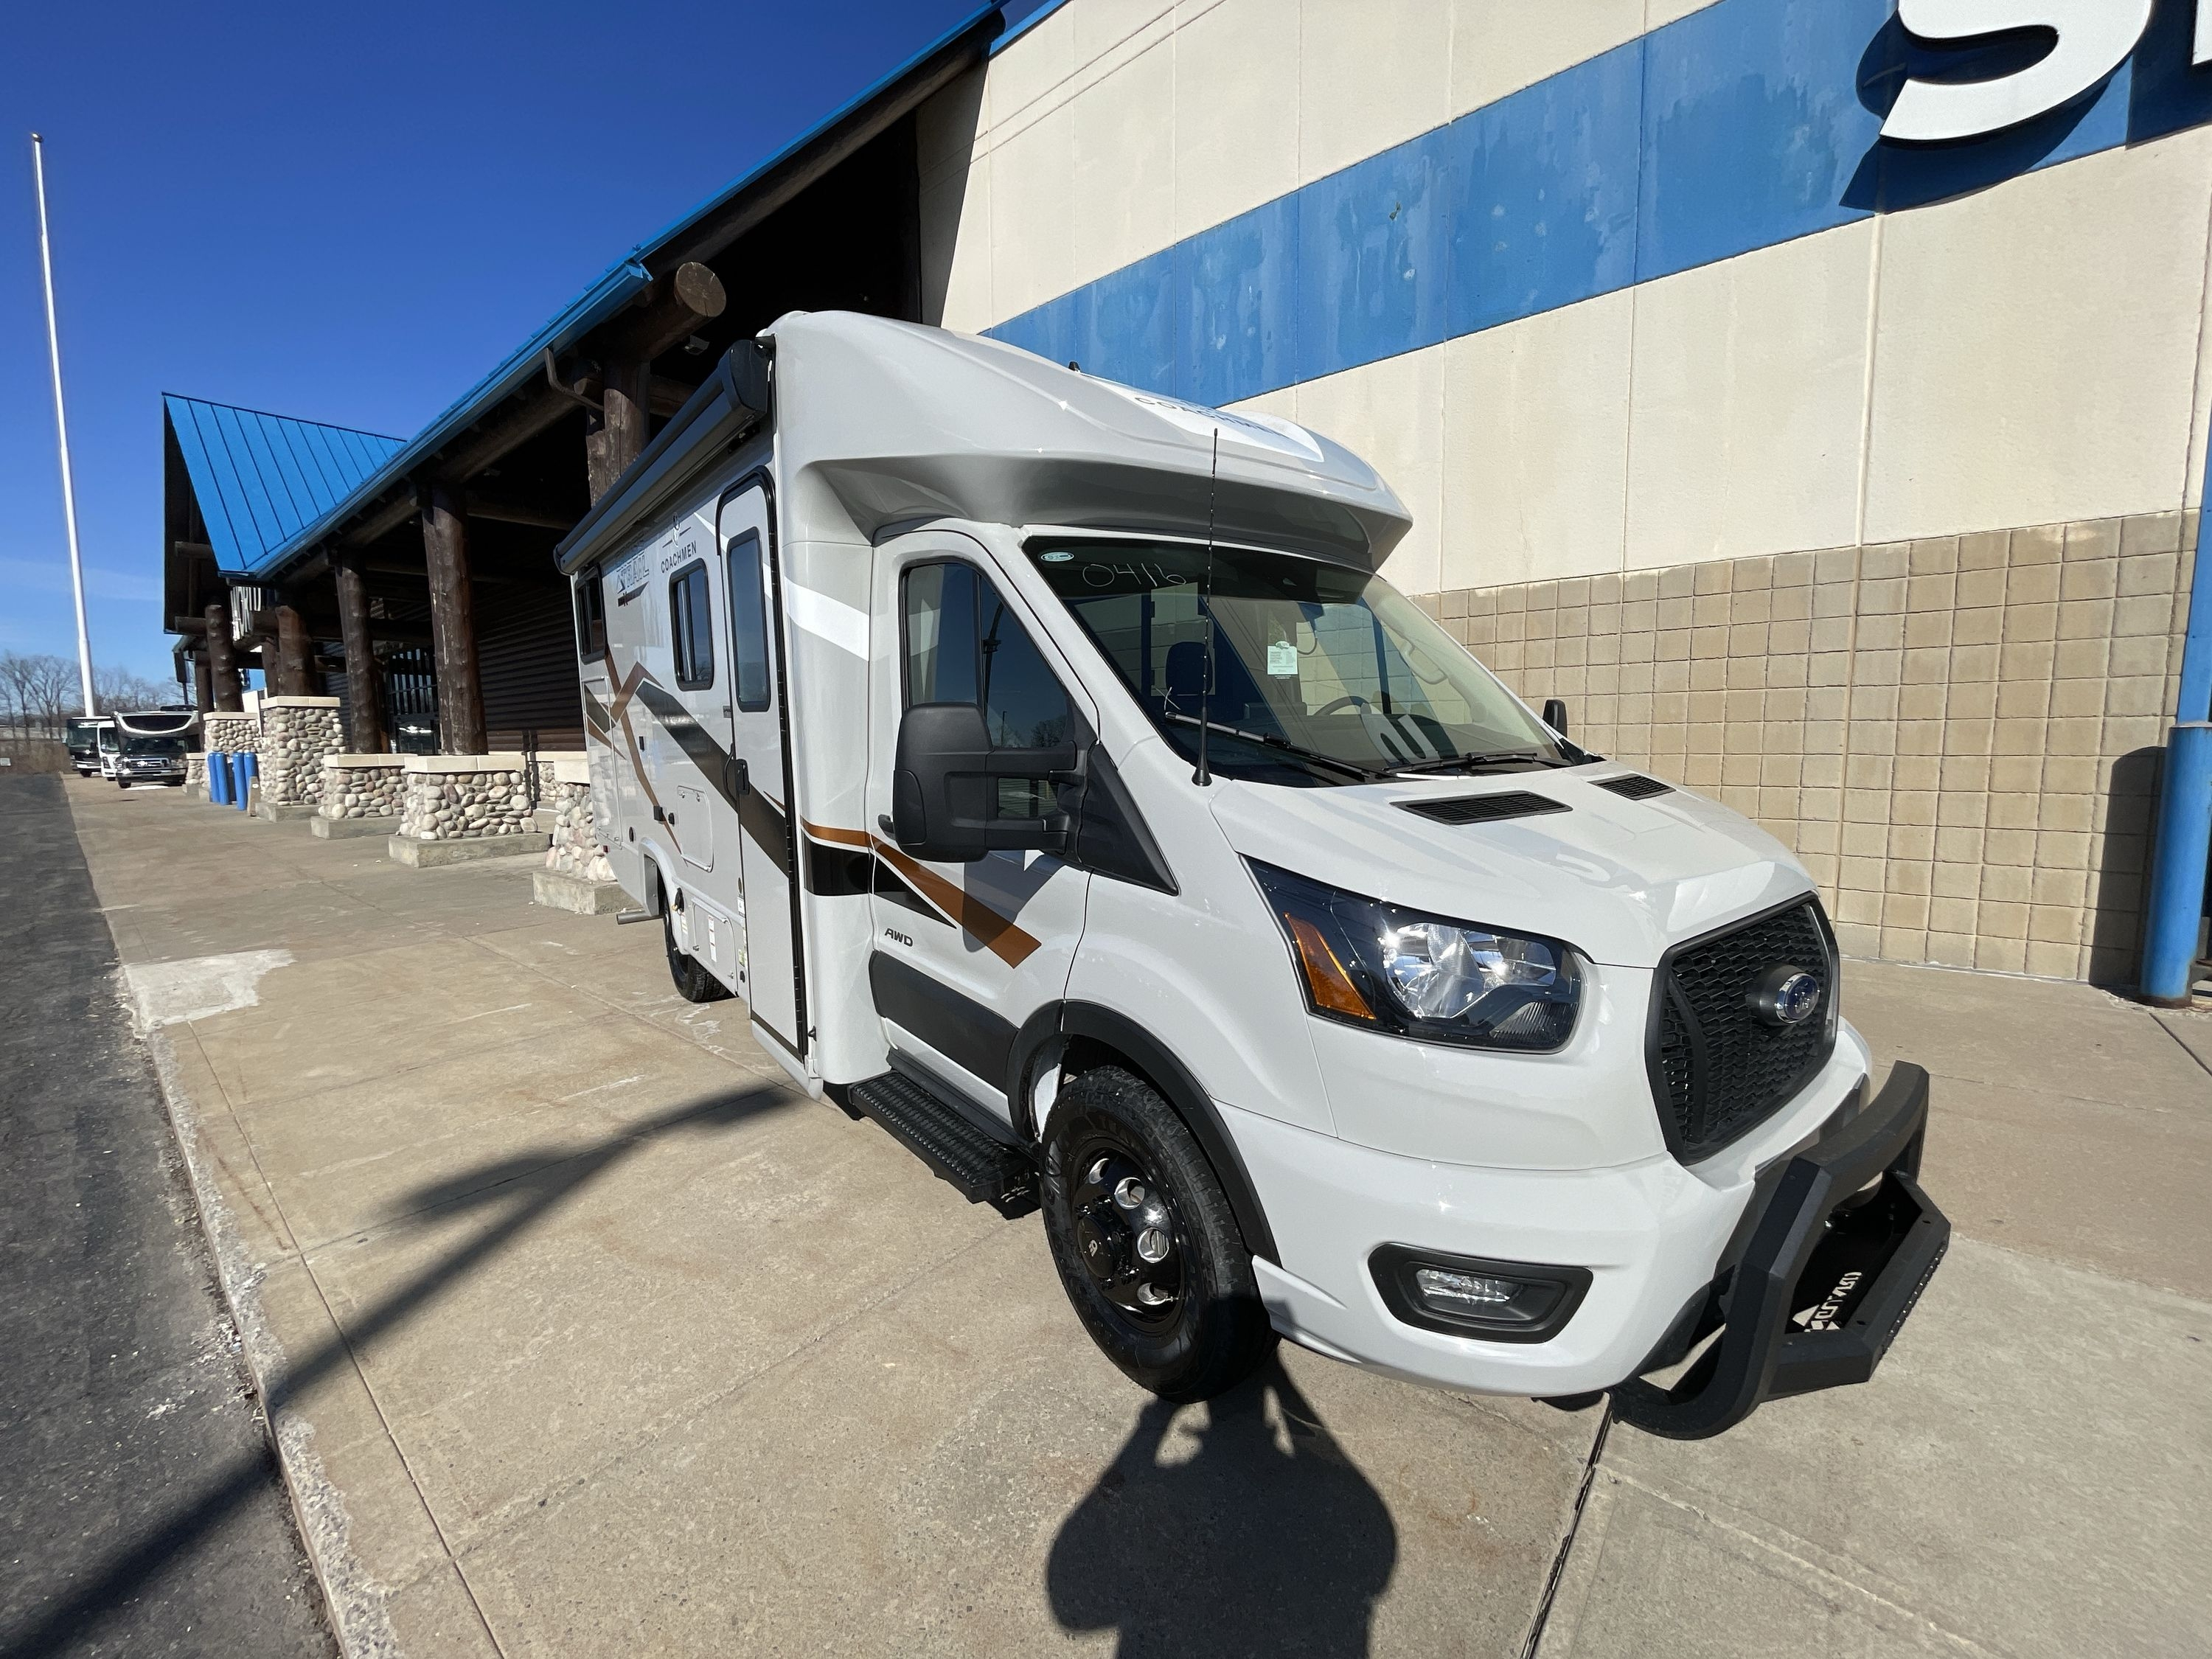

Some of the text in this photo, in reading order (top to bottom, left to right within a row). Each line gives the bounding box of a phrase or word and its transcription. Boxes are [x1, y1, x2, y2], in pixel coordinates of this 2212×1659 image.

[661, 540, 697, 574] COACHMEN
[1082, 563, 1187, 588] 0416
[884, 928, 914, 947] AWD
